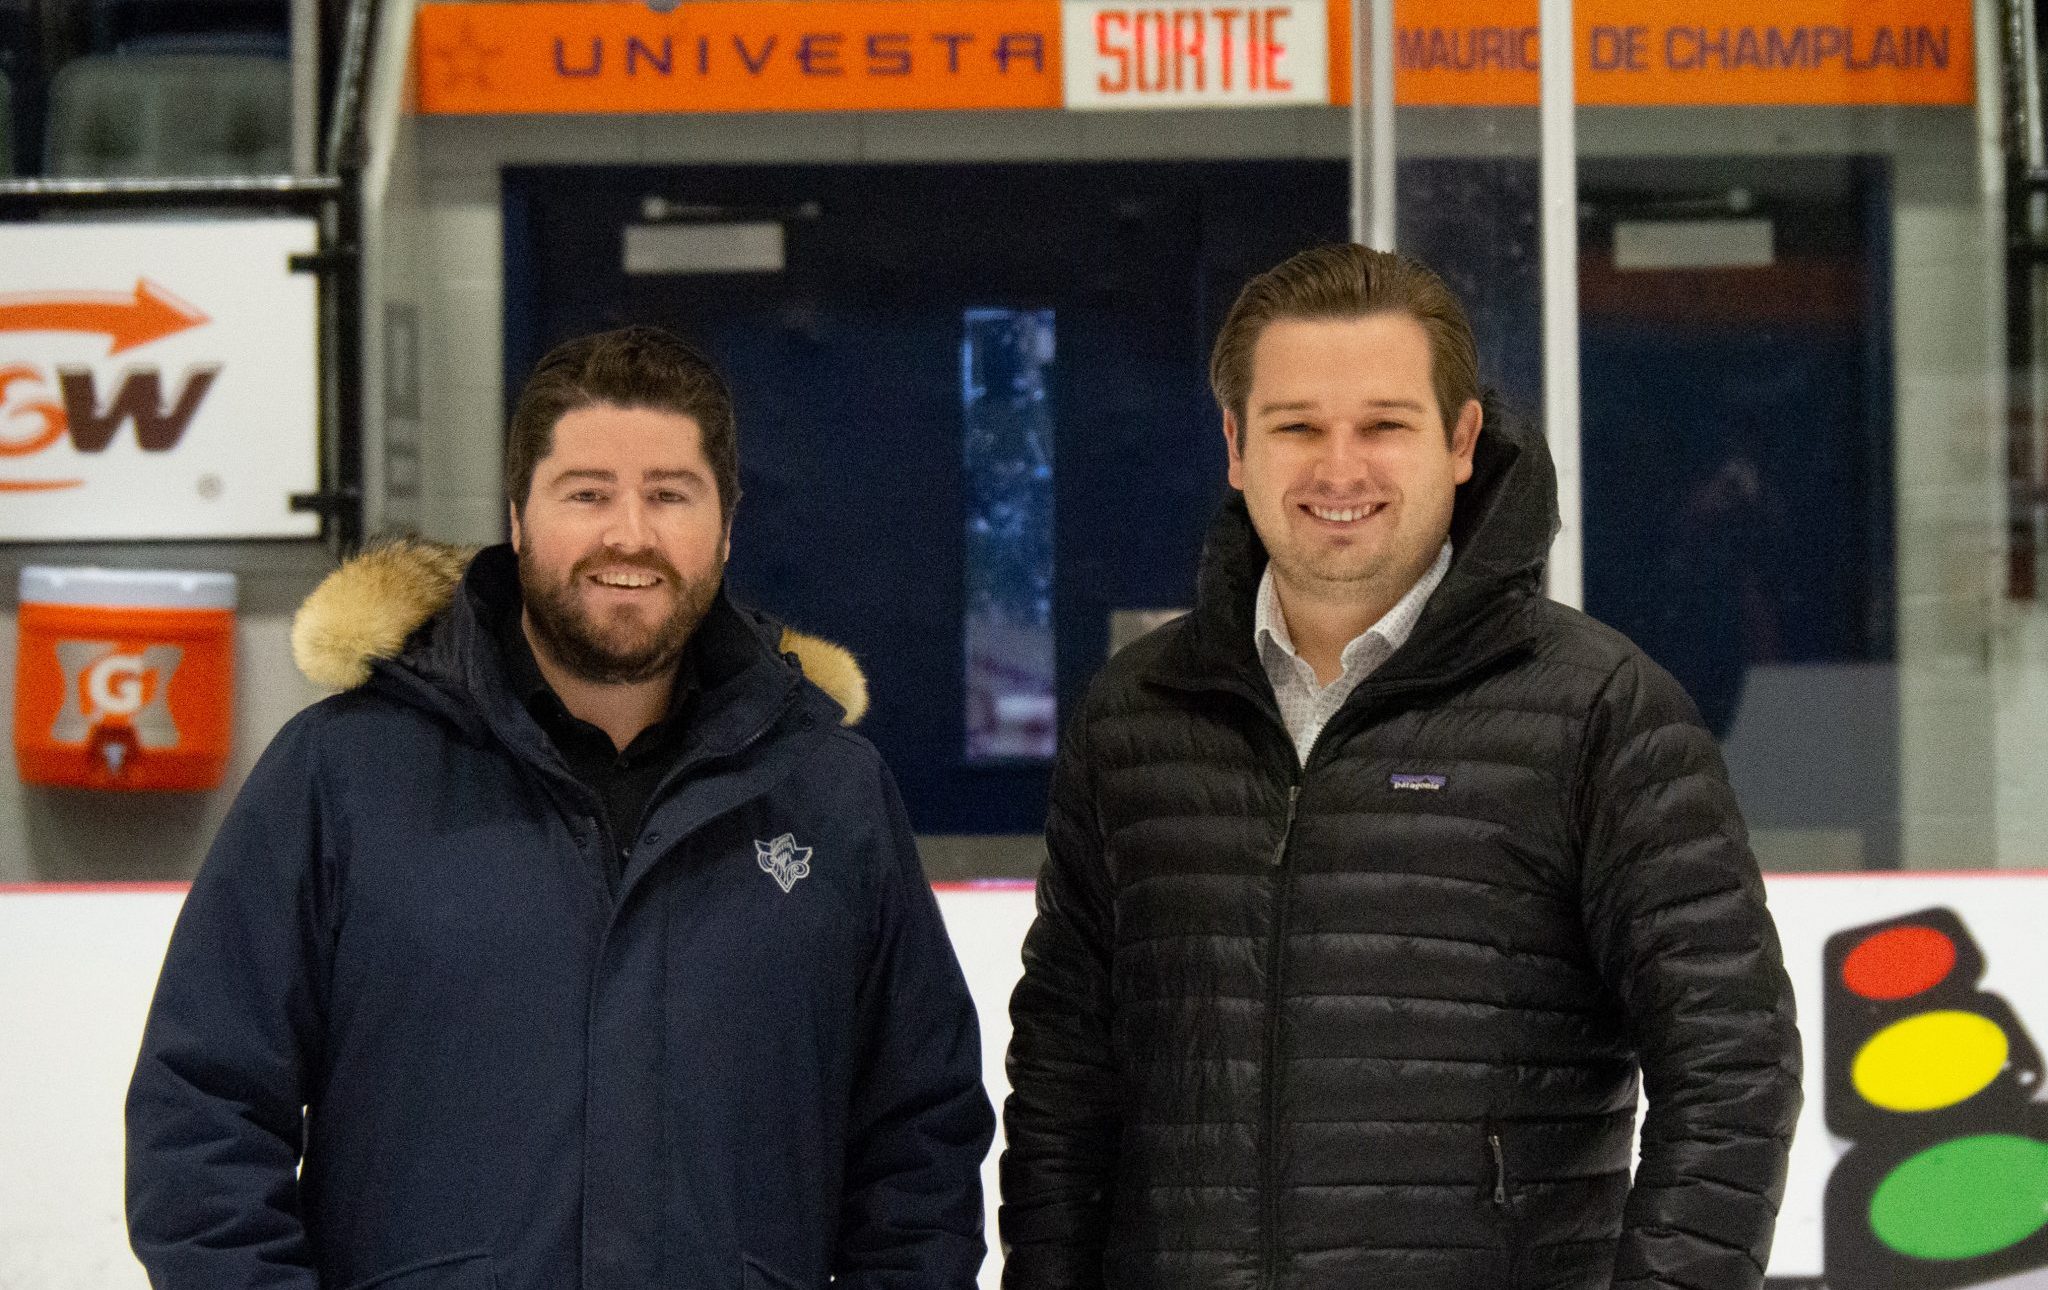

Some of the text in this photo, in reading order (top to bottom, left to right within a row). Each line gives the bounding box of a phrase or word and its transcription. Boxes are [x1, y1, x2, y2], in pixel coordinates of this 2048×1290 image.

[553, 32, 1046, 78] UNIVESTA
[1094, 8, 1292, 93] SORTIE
[1397, 26, 1951, 73] MAURIC DE CHAMPLAIN
[91, 654, 145, 714] G
[1393, 782, 1440, 790] patagonia
